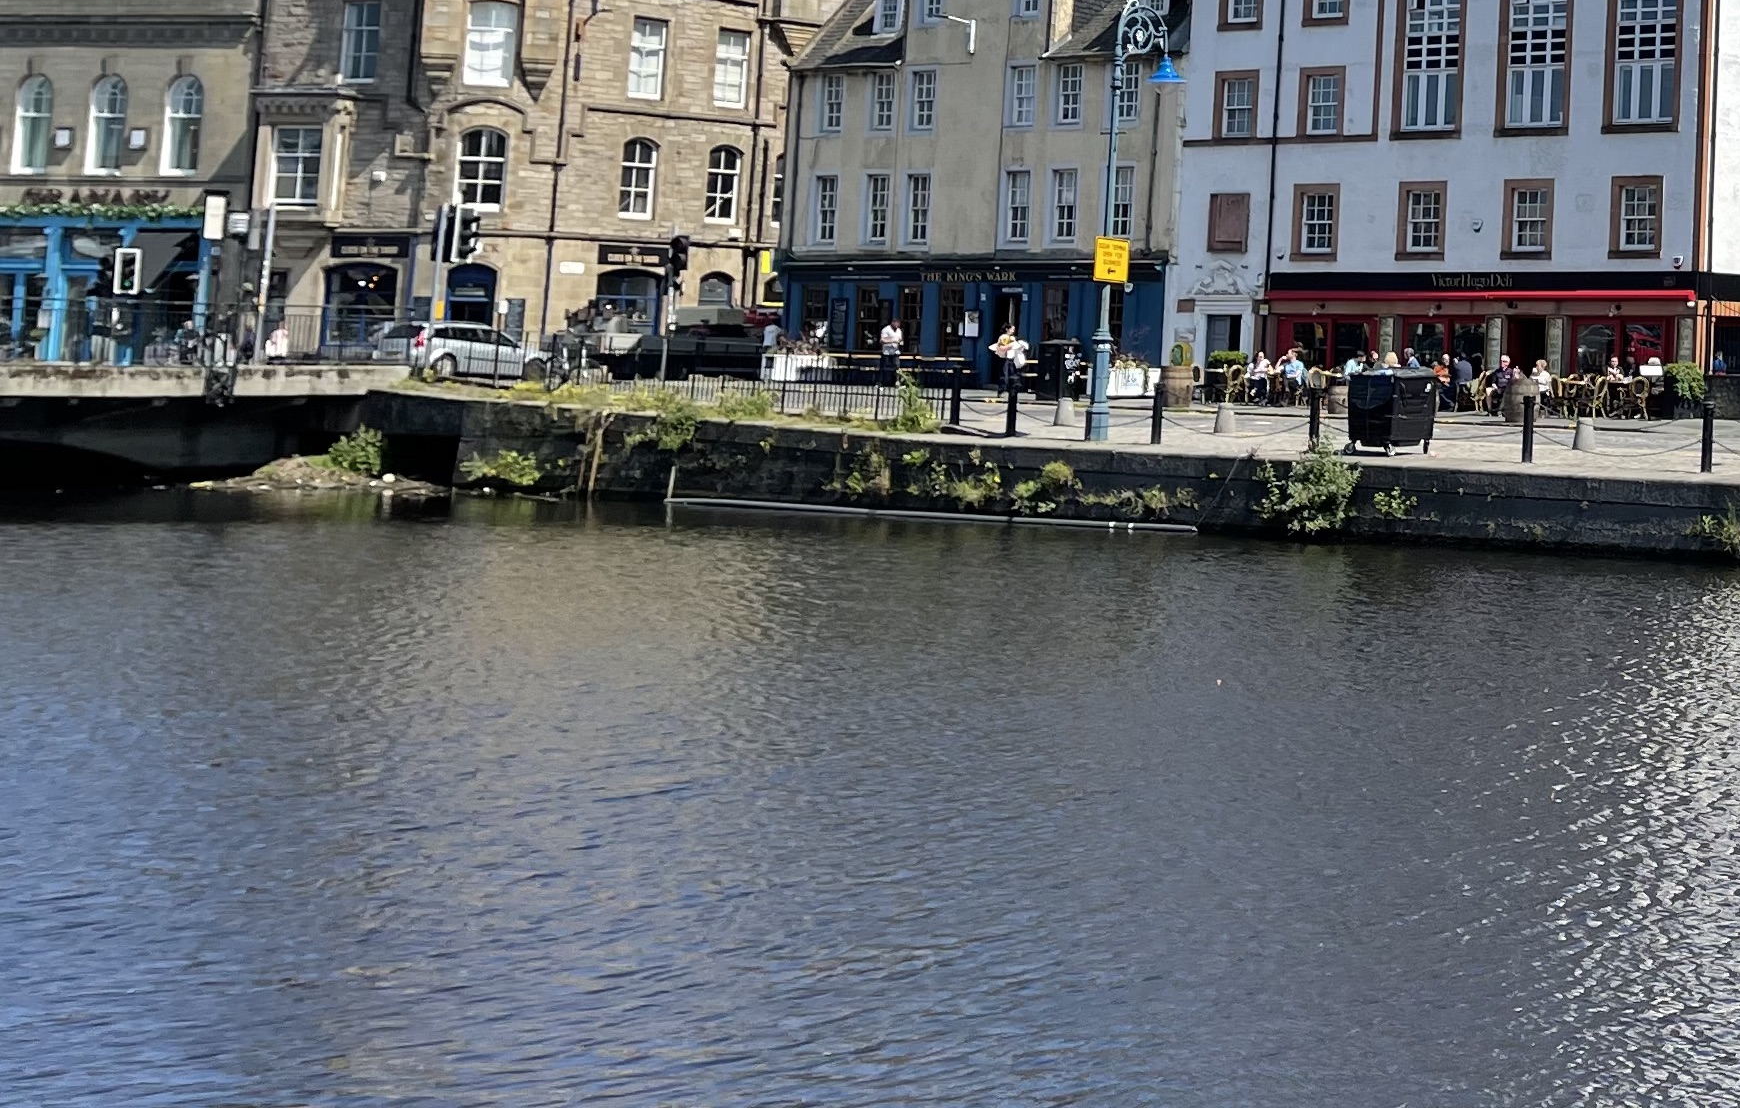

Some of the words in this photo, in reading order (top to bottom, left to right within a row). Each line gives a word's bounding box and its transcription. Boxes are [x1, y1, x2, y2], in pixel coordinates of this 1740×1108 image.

[920, 271, 942, 282] THE
[947, 271, 982, 282] KING'S
[986, 271, 1017, 282] WARK
[1431, 273, 1461, 287] Victor
[1461, 273, 1490, 290] Hugo
[1490, 273, 1513, 287] Deli
